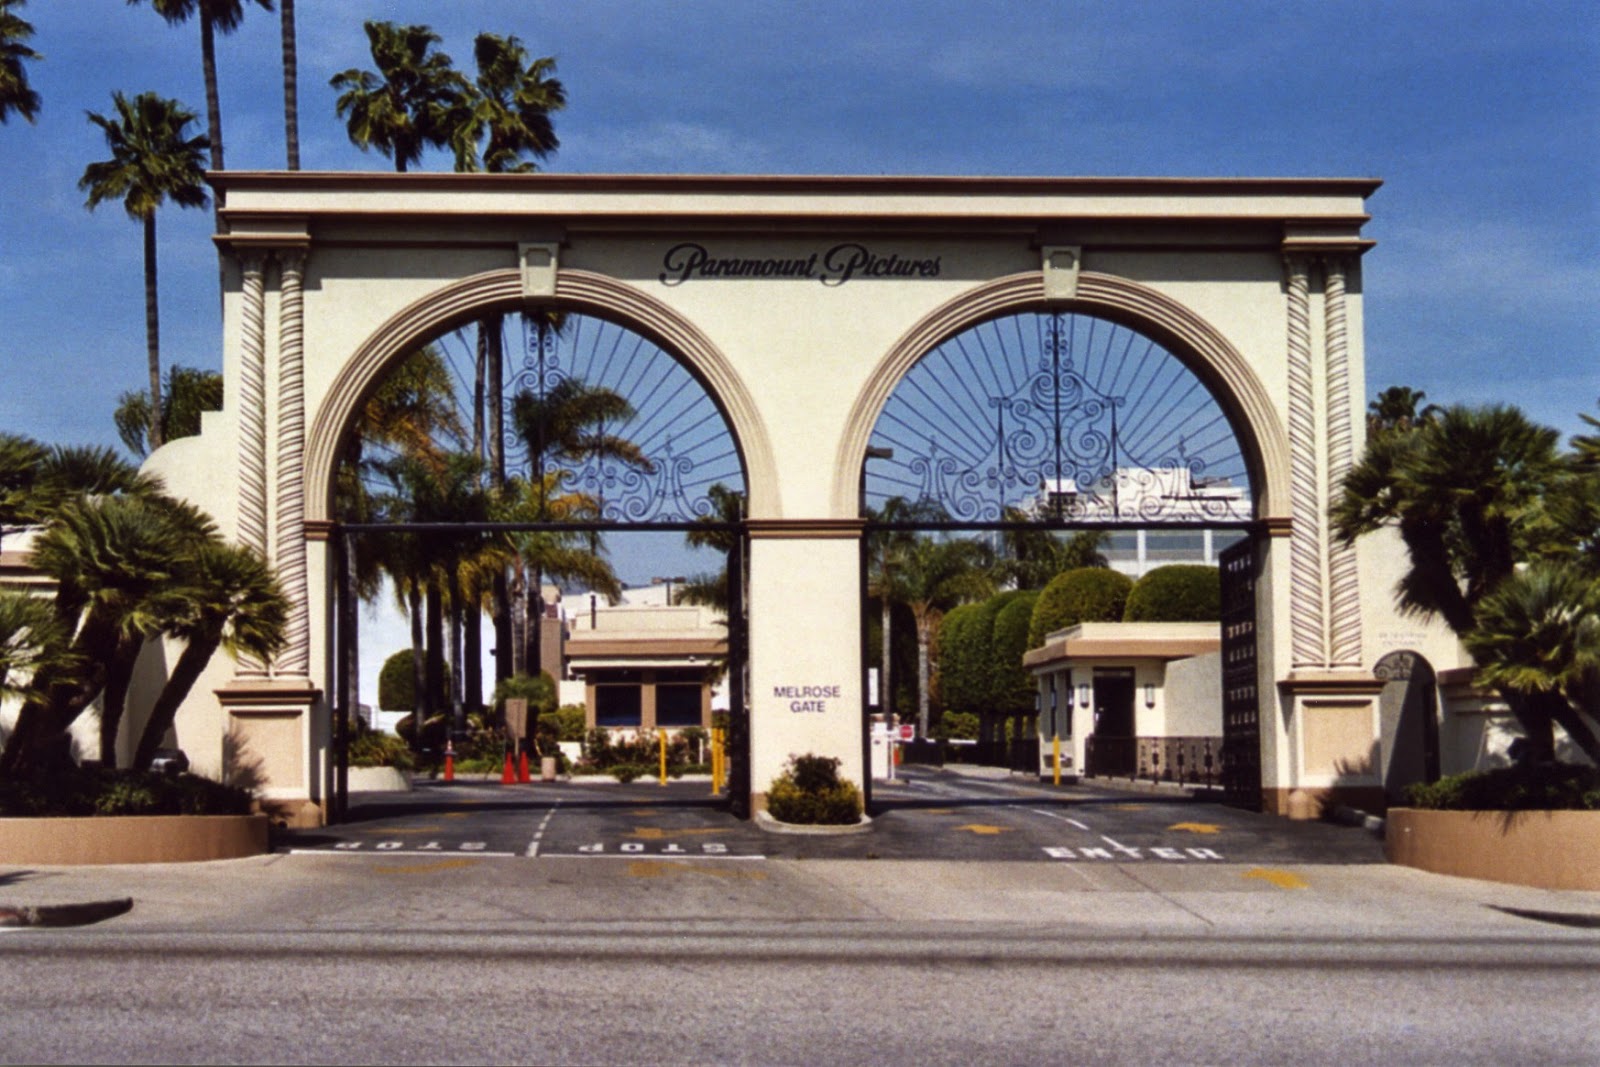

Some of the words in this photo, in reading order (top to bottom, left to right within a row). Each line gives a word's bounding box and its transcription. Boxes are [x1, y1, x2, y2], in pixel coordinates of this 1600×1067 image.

[659, 242, 818, 287] Paramount
[820, 243, 941, 287] Pictures
[774, 685, 841, 698] MELROSE
[790, 700, 825, 713] GATE
[578, 843, 729, 854] STOP
